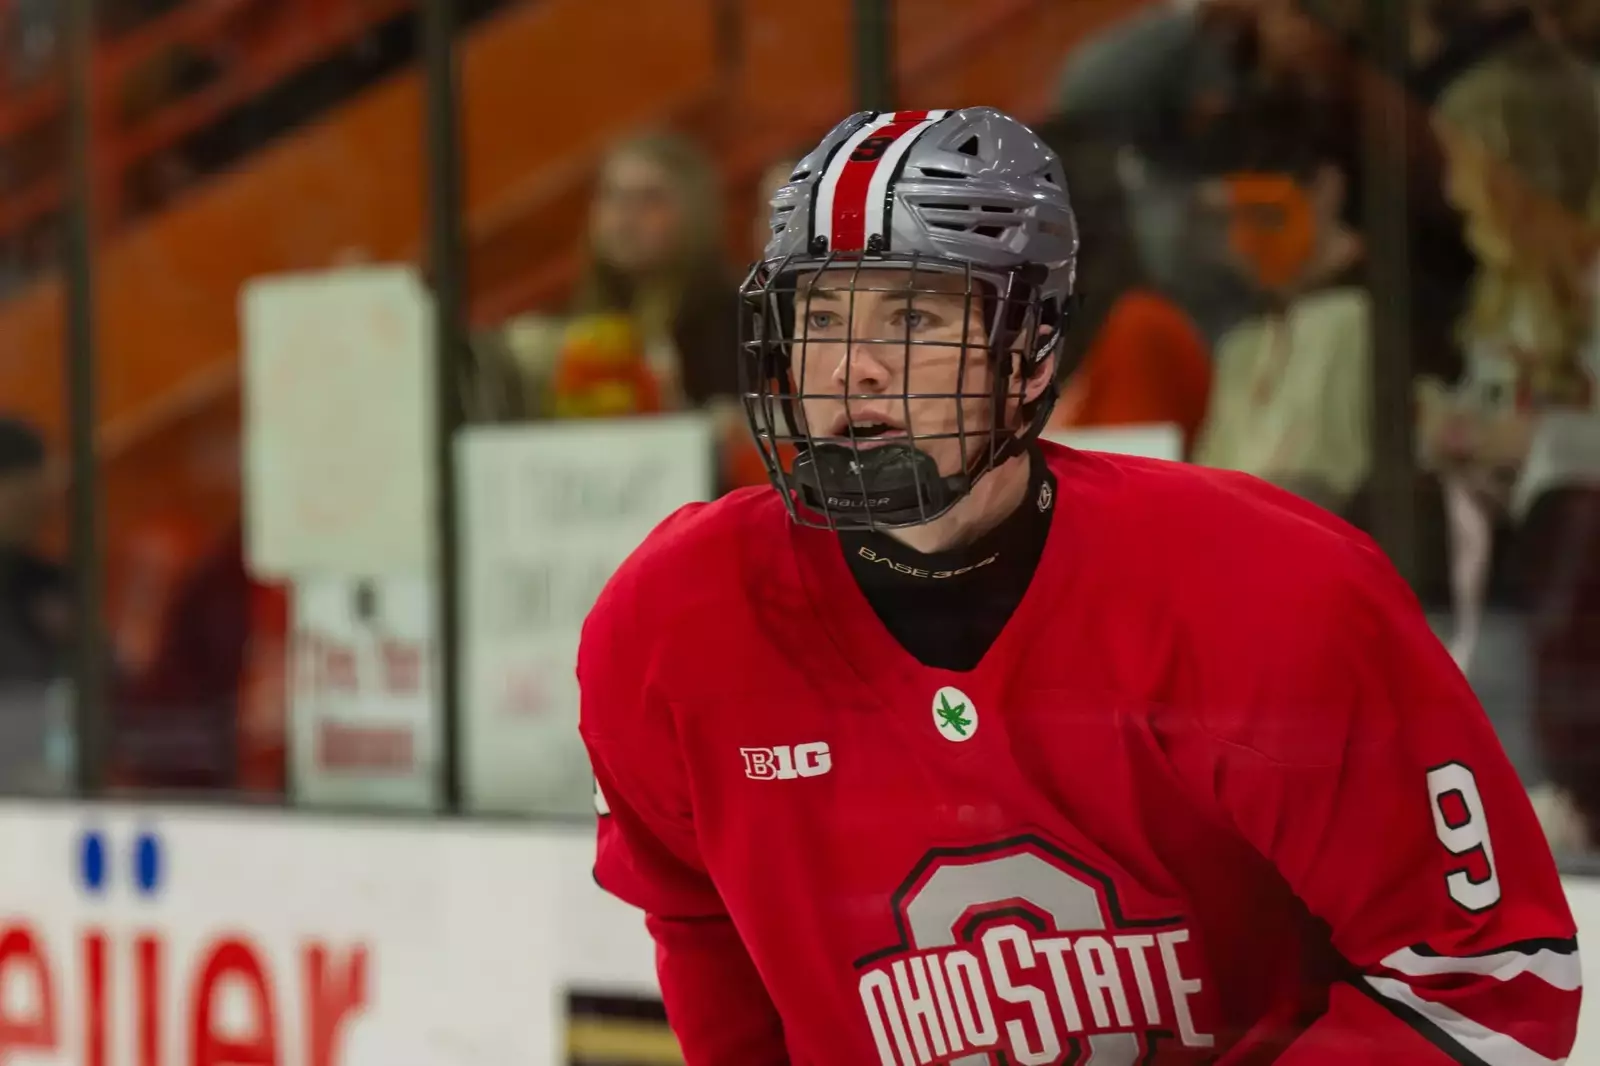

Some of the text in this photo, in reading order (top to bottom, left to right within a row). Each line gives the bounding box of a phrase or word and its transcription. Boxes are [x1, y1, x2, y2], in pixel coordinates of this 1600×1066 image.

[1426, 760, 1501, 914] 9
[858, 924, 1214, 1066] OHIO STATE
